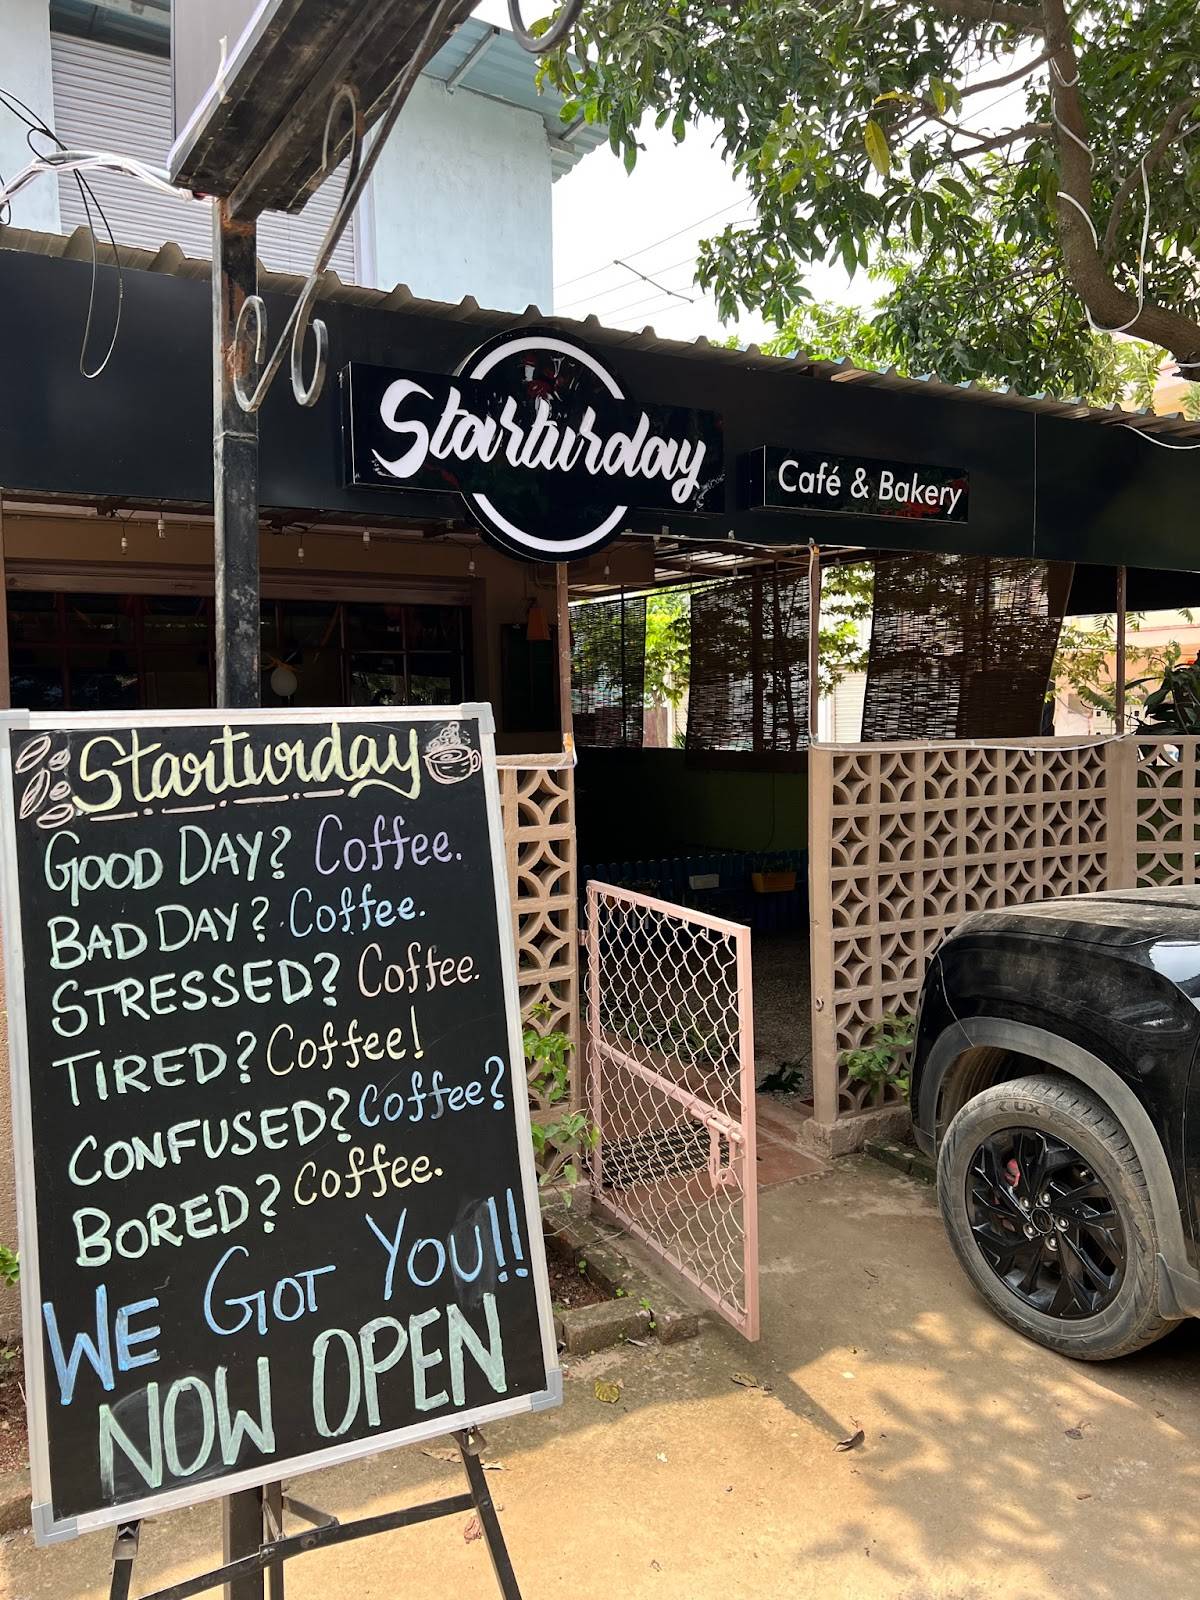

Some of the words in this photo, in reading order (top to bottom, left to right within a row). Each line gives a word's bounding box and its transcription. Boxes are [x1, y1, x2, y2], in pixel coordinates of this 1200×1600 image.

[371, 379, 706, 503] Starturday
[778, 459, 841, 496] Café
[850, 467, 869, 499] &
[879, 470, 962, 515] Bakery
[72, 721, 421, 813] Starturday
[178, 824, 292, 885] DAY?
[314, 814, 463, 875] Coffee.
[47, 916, 148, 970] BAD
[289, 883, 427, 939] Coffee.
[51, 951, 341, 1038] STRESSED?
[358, 941, 481, 998] Coffee.
[52, 1031, 257, 1106] TIRED?
[266, 1006, 425, 1077] Coffee!
[67, 1088, 352, 1187] CONFUSED?
[358, 1055, 506, 1128] Coffee?
[72, 1173, 281, 1267] BORED?
[293, 1143, 443, 1206] Coffee.
[42, 1284, 162, 1406] WE
[203, 1245, 337, 1336] GOT
[364, 1187, 529, 1302] YOU!!
[99, 1356, 276, 1500] NOW
[312, 1293, 507, 1438] OPEN
